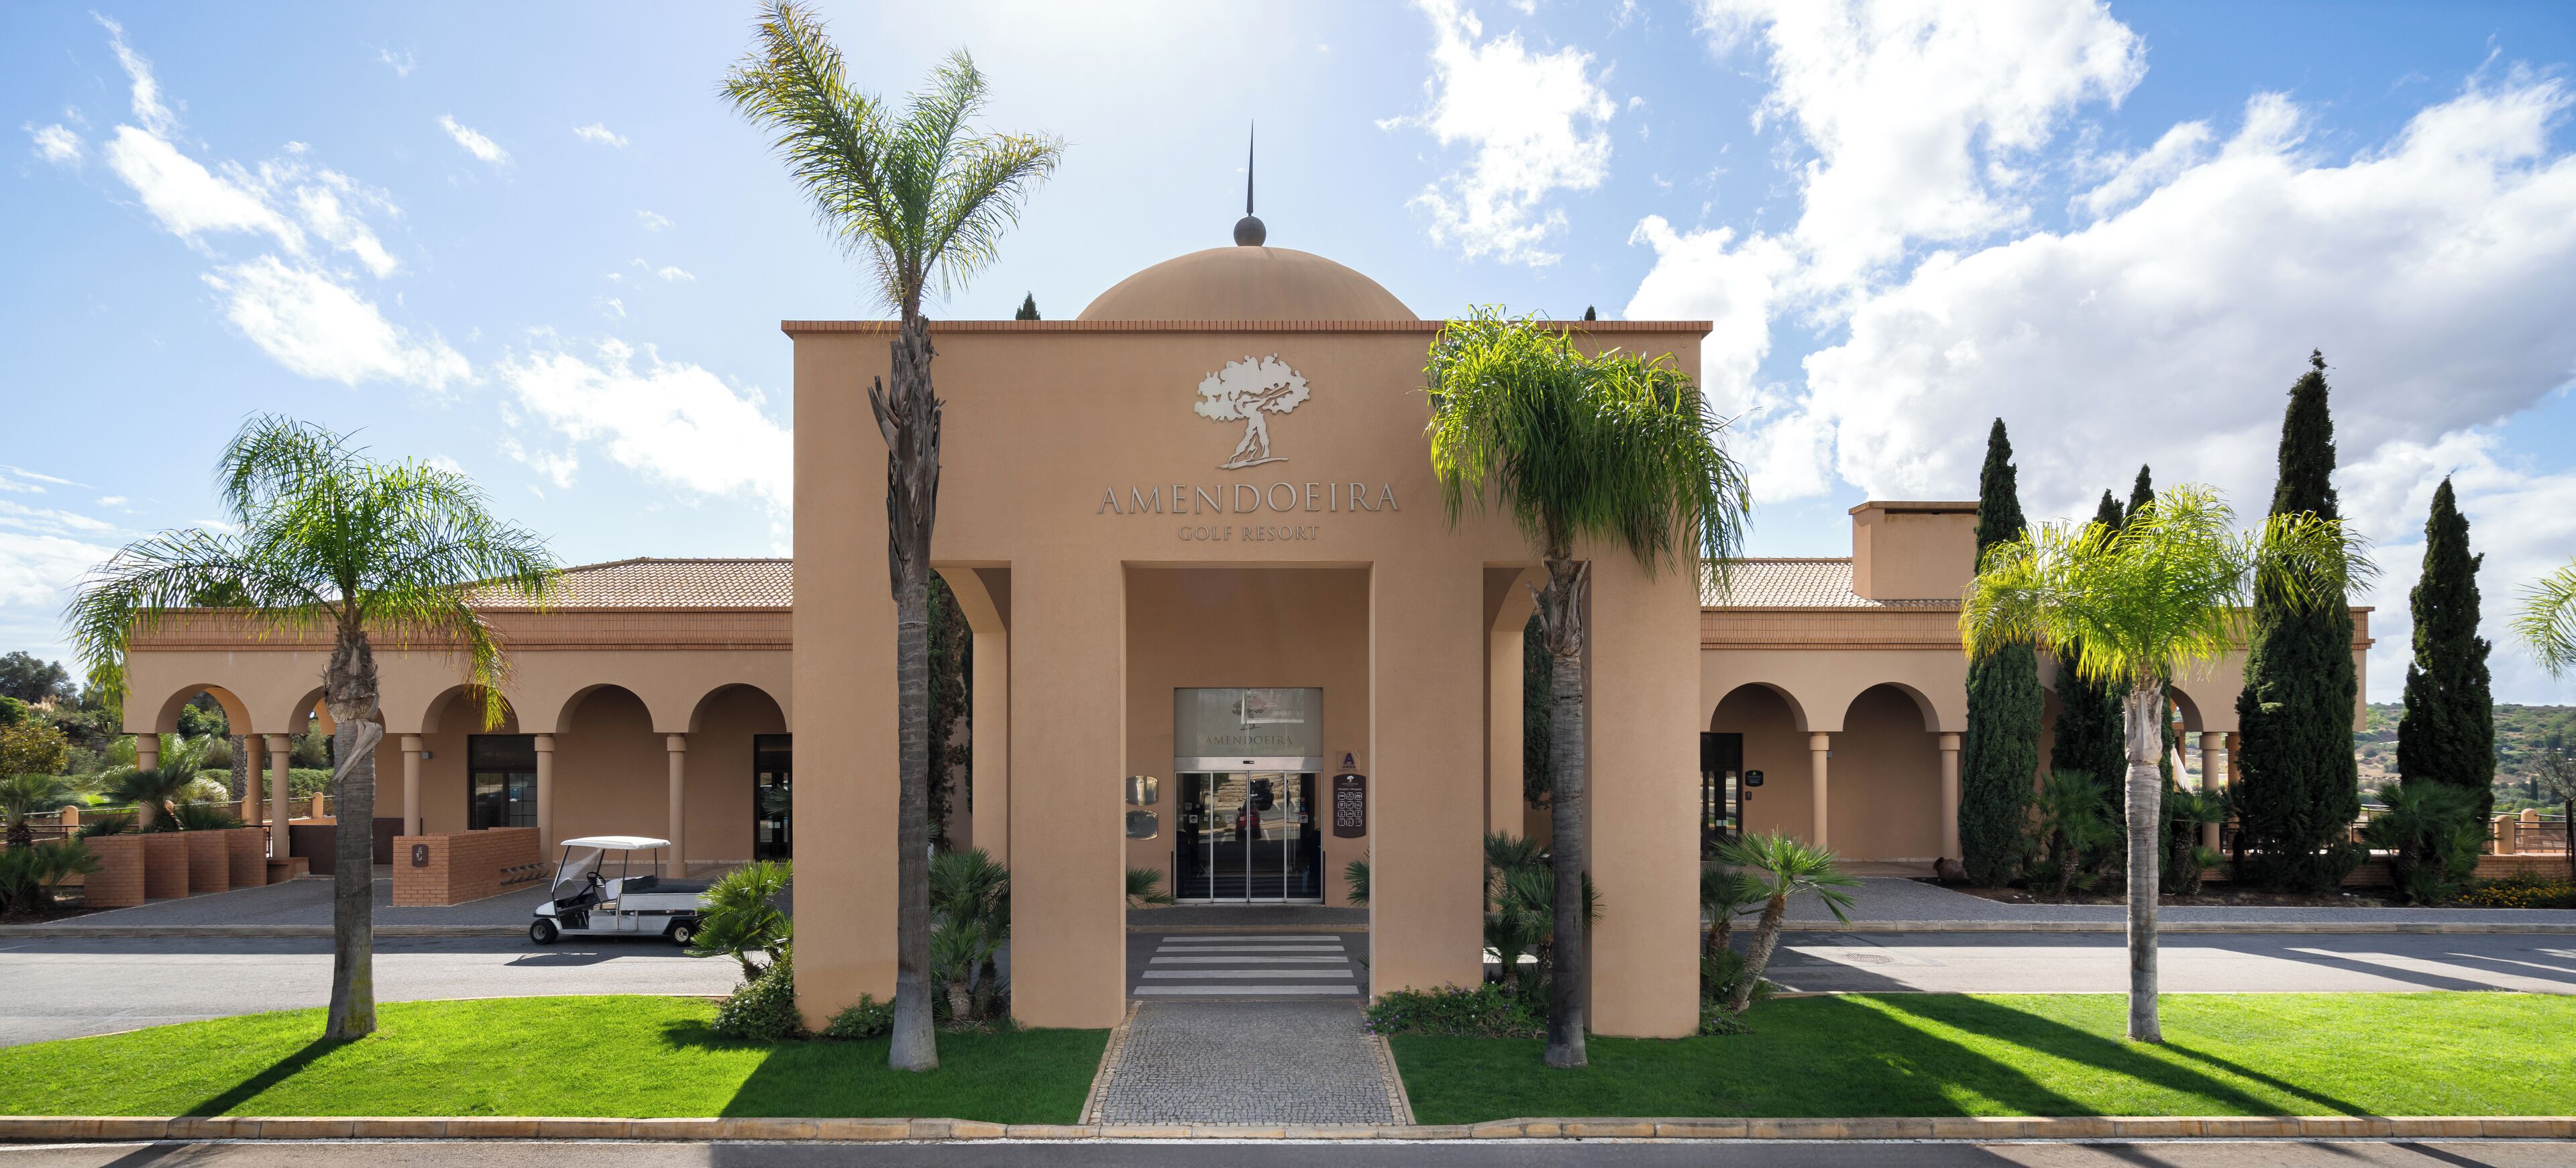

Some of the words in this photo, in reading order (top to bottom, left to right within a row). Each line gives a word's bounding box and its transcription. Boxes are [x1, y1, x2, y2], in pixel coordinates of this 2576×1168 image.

[1097, 482, 1400, 515] AMENDOEIRA
[1178, 525, 1232, 541] GOLF
[1242, 525, 1320, 541] RESORT
[1205, 735, 1293, 745] AMENDOEIRA
